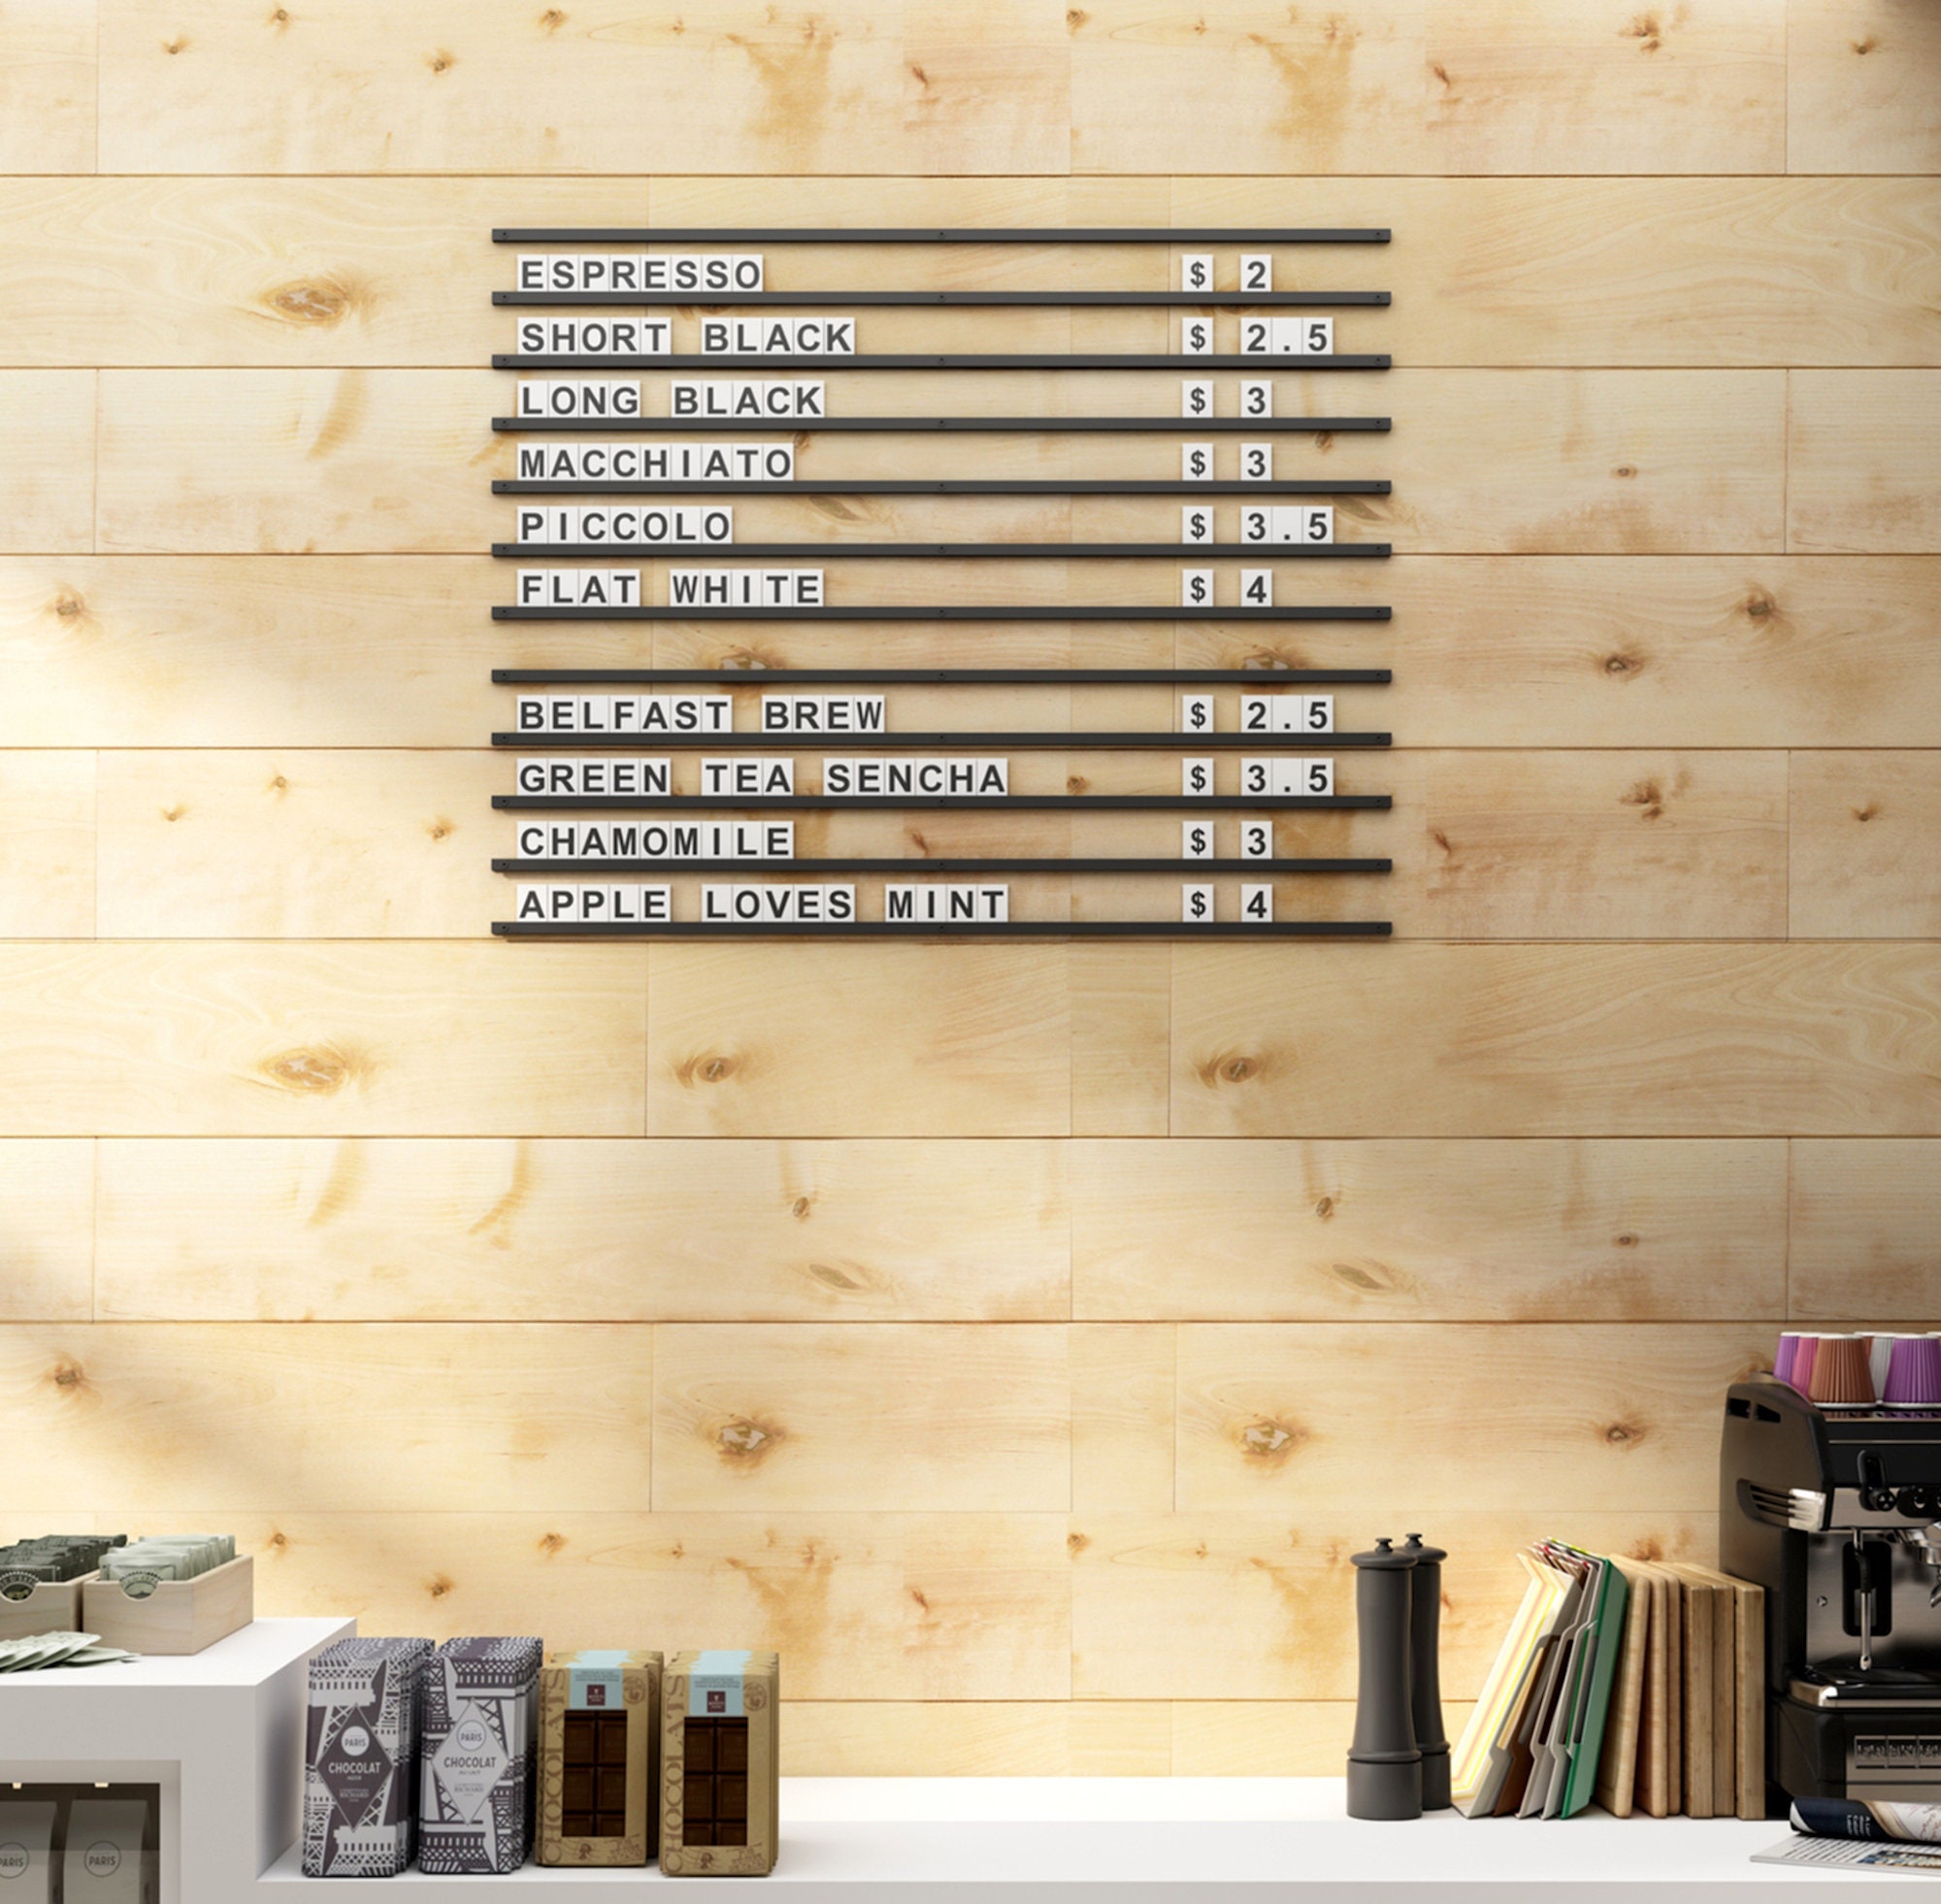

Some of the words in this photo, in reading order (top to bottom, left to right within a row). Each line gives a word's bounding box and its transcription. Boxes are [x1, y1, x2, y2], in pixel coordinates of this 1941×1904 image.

[522, 260, 760, 289] ESPRESSO
[1247, 261, 1266, 289] 2
[522, 323, 667, 352] SHORT
[705, 324, 851, 352] BLACK
[1247, 323, 1328, 352] 2.5
[523, 386, 638, 415] LONG
[674, 386, 821, 414] BLACK
[1247, 386, 1266, 414] 3
[521, 449, 791, 477] MACCHIATO
[1247, 449, 1266, 477] 3
[522, 512, 730, 542] PICCOLO
[1247, 512, 1328, 541] 3.5
[522, 575, 636, 604] FLAT
[673, 575, 819, 604] WHITE
[1246, 575, 1267, 604] 4
[520, 701, 728, 730] BELFAST
[765, 701, 882, 730] BREW
[1247, 701, 1328, 730] 2.5
[519, 764, 667, 793] GREEN
[706, 764, 791, 793] TEA
[827, 764, 1005, 793] SENCHA
[1247, 764, 1328, 793] 3.5
[520, 827, 789, 856] CHAMOMILE
[1247, 827, 1267, 856] 3
[519, 890, 666, 919] APPLE
[707, 890, 851, 919] LOVES
[889, 890, 1004, 919] MINT
[1246, 890, 1267, 919] 4
[344, 1737, 367, 1748] PARIS
[460, 1732, 482, 1742] PARIS
[328, 1762, 381, 1774] CHOCOLAT
[444, 1756, 497, 1768] CHOCOLAT
[544, 1669, 565, 1863] CHOCOLATS
[665, 1675, 685, 1872] CHOCOLATS
[88, 1855, 116, 1866] PARIS
